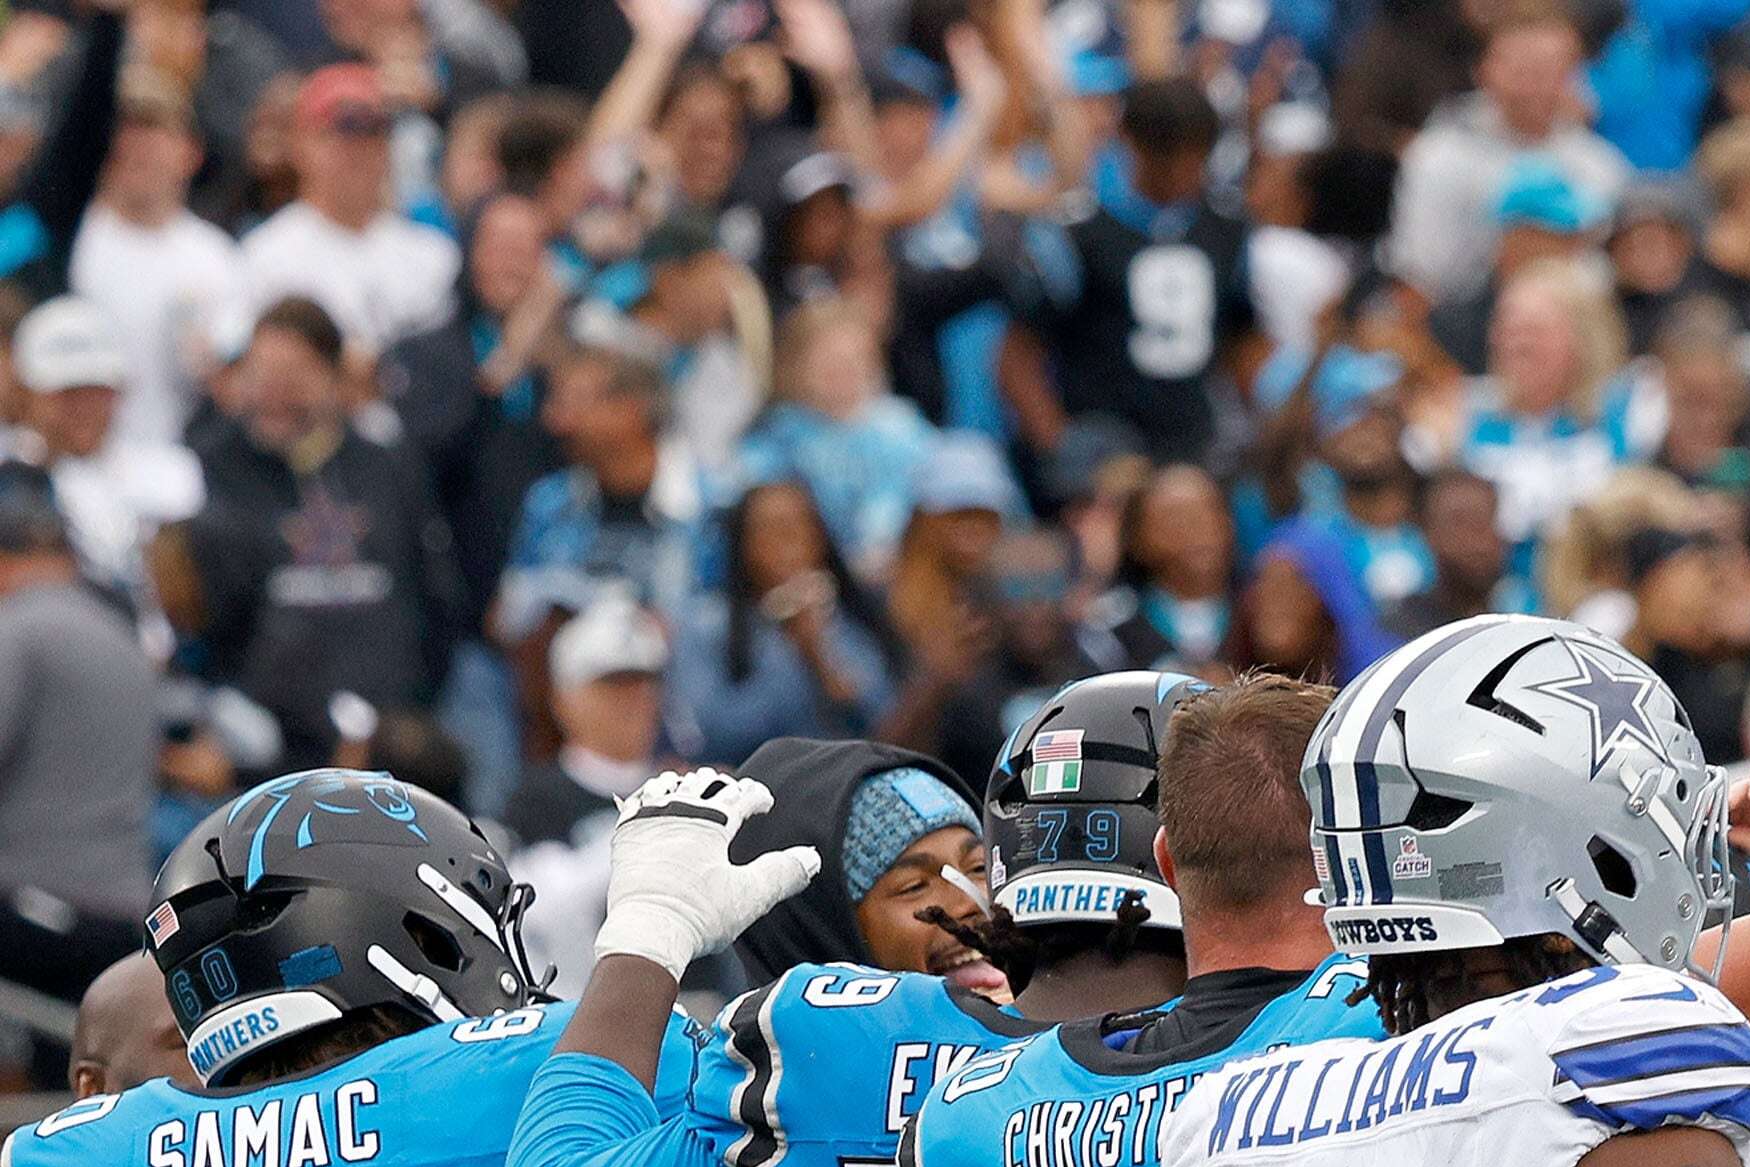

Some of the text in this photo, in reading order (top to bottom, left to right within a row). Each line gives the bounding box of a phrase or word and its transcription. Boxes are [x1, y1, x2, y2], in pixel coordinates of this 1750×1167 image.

[1127, 242, 1217, 381] 9
[1037, 809, 1121, 863] 79
[1395, 860, 1429, 873] CATCH
[171, 949, 238, 1022] 60
[1208, 1016, 1496, 1158] WILLIAMS
